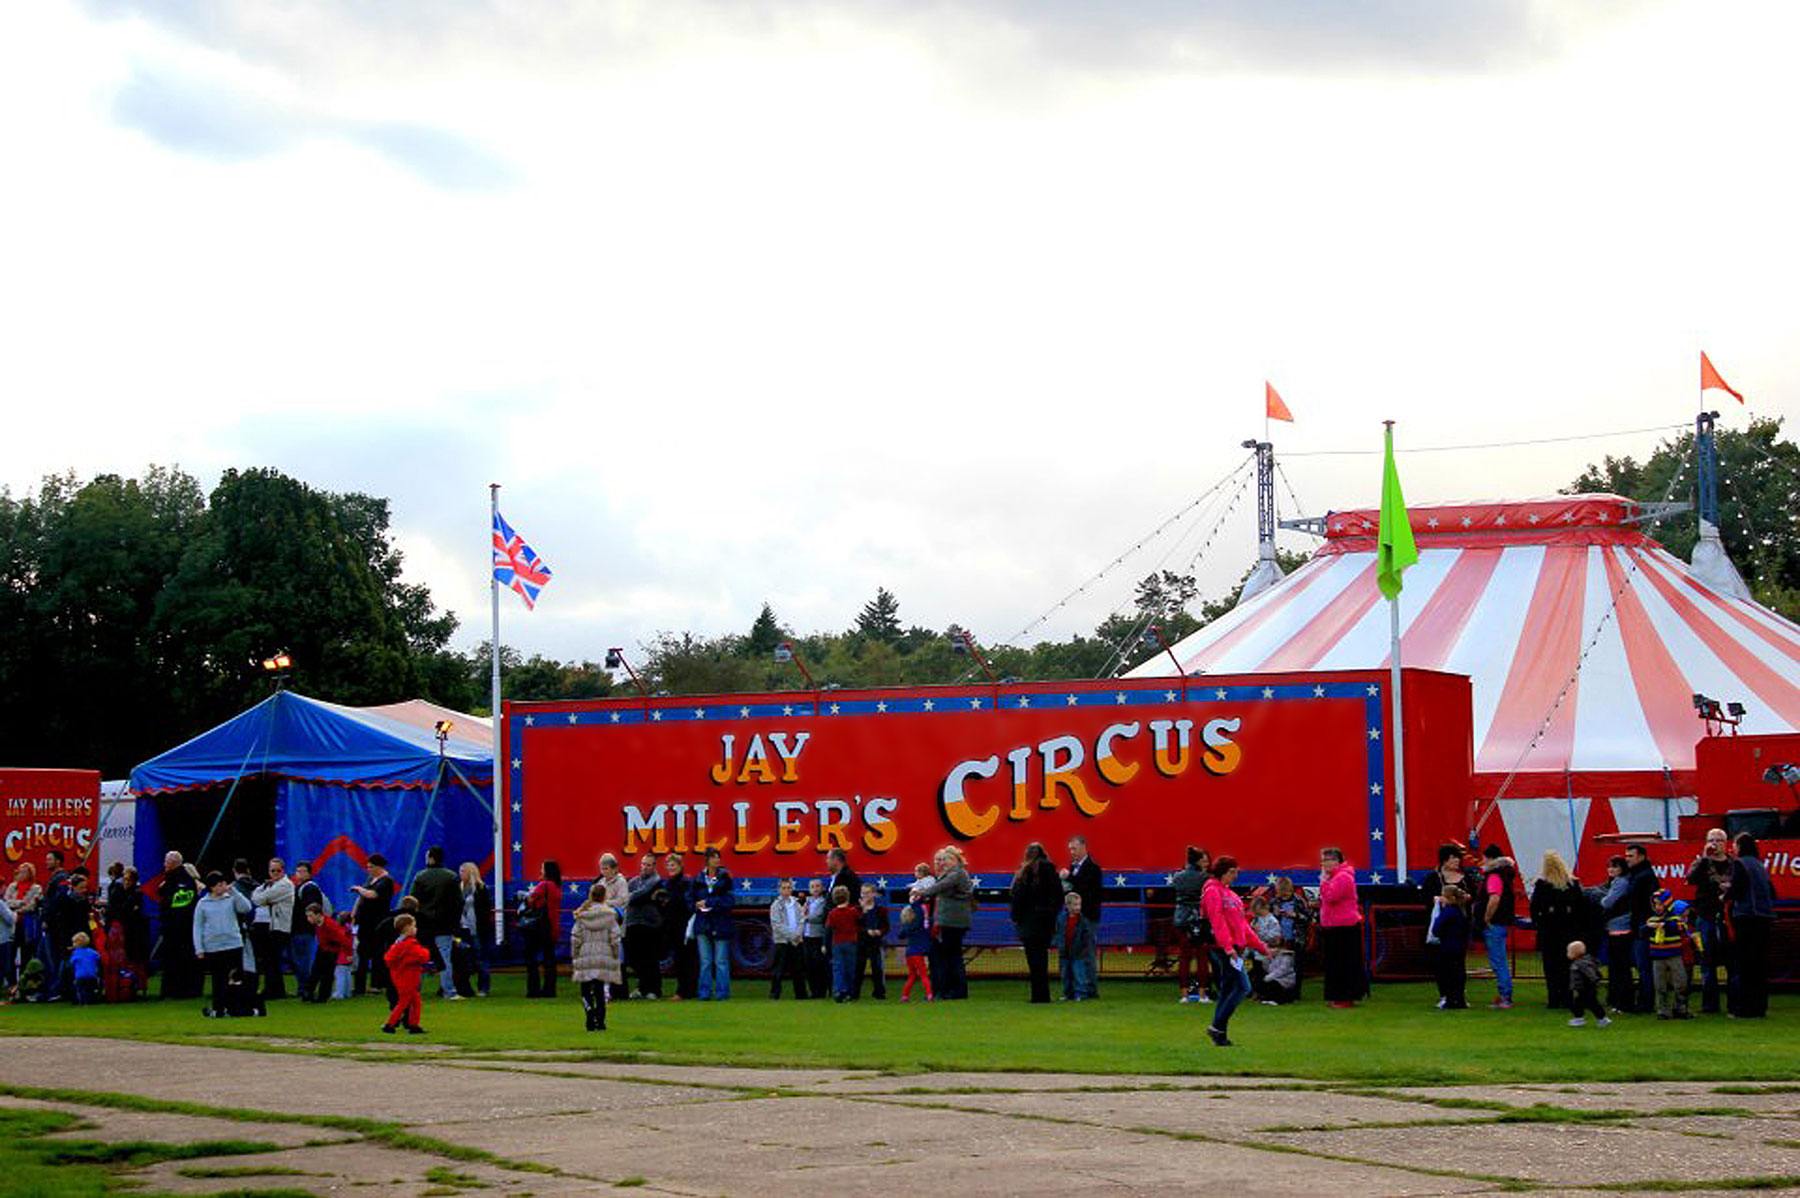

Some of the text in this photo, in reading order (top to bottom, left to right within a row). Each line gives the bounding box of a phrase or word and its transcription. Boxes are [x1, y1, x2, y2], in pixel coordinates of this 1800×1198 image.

[711, 732, 810, 783] JAY
[940, 717, 1242, 838] CIRCUS
[6, 797, 93, 816] JAY MILLER'S
[622, 795, 898, 854] MILLER'S
[5, 821, 92, 861] CIRCUS
